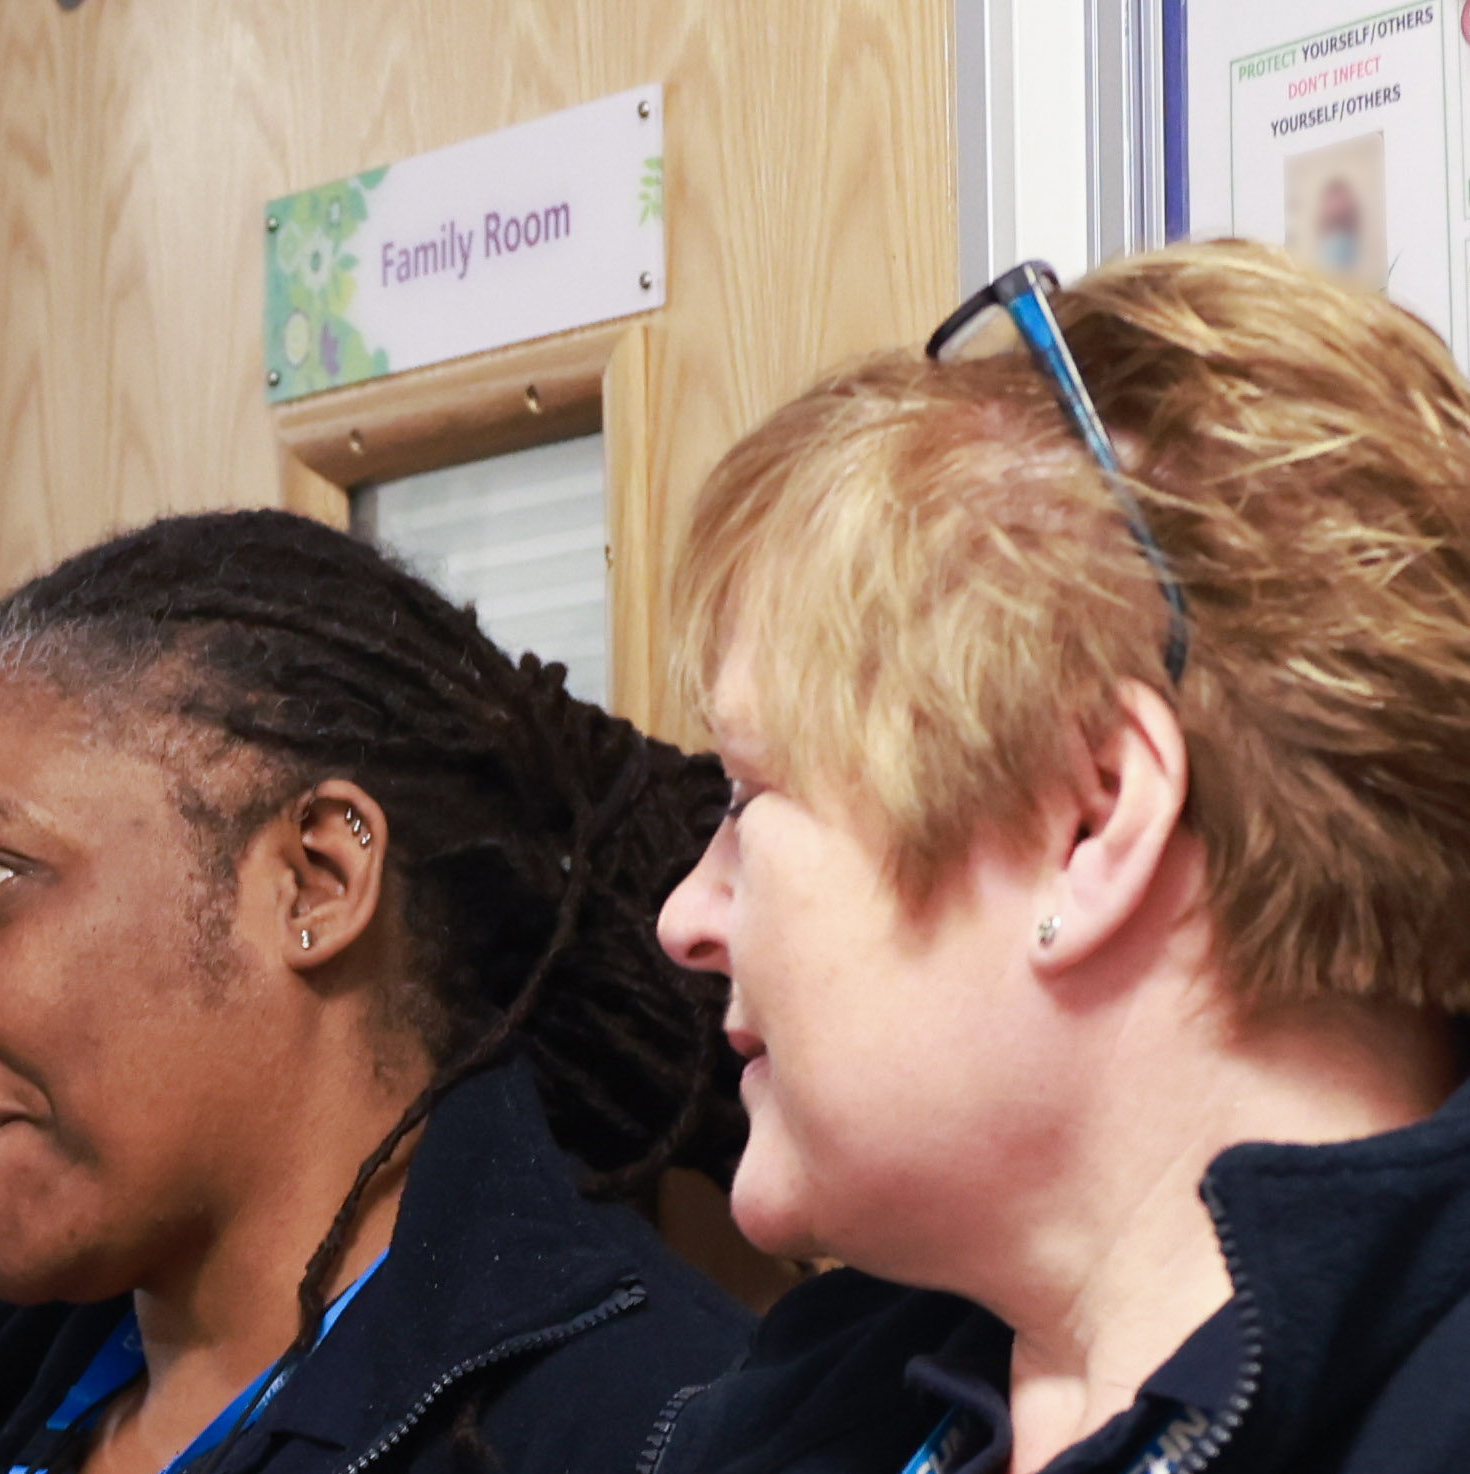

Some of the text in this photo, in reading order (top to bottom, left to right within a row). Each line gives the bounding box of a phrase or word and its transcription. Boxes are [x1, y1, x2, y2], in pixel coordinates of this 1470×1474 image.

[1239, 6, 1434, 82] PROTECT YOURSELF/OTHERS
[1288, 56, 1382, 100] DON'T INFECT
[1271, 84, 1402, 137] YOURSELF/OTHERS
[381, 201, 571, 287] Family Room
